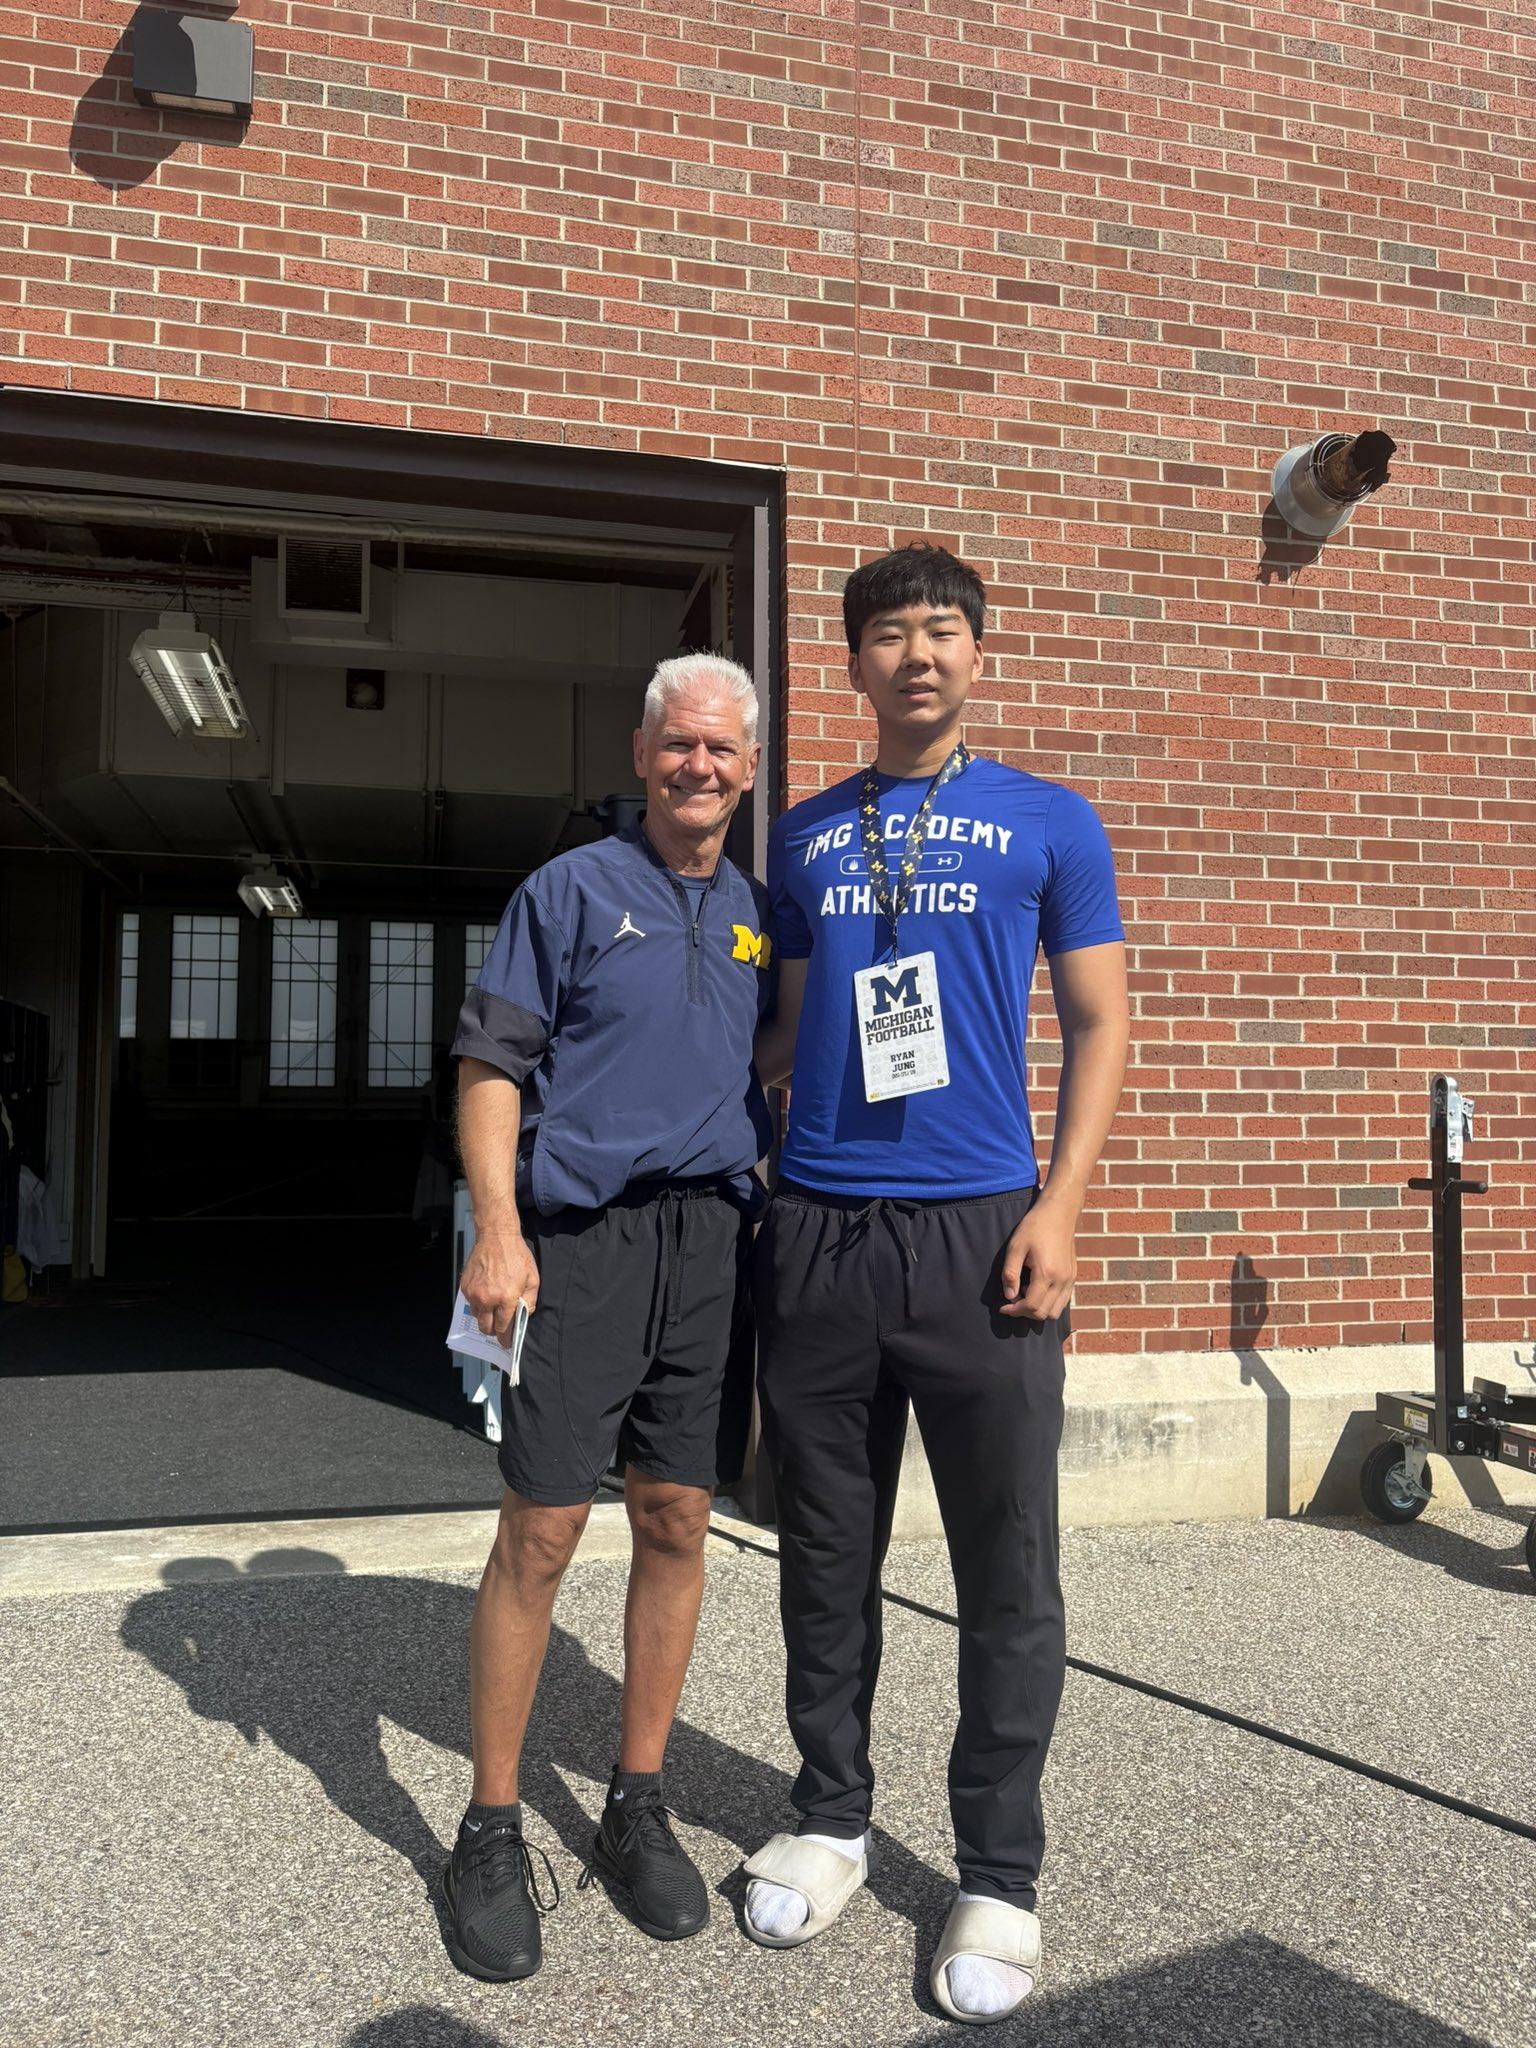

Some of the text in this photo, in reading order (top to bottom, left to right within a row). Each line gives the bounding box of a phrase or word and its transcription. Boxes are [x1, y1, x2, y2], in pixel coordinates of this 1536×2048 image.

[804, 814, 1013, 867] IMG CDEMY
[821, 883, 977, 916] ATHTICS
[731, 924, 773, 970] M
[870, 966, 922, 1015] M
[865, 1005, 934, 1033] MICHIGAN
[867, 1020, 935, 1046] FOOTBALL
[890, 1050, 915, 1062] RYAN
[892, 1060, 915, 1072] JUNG
